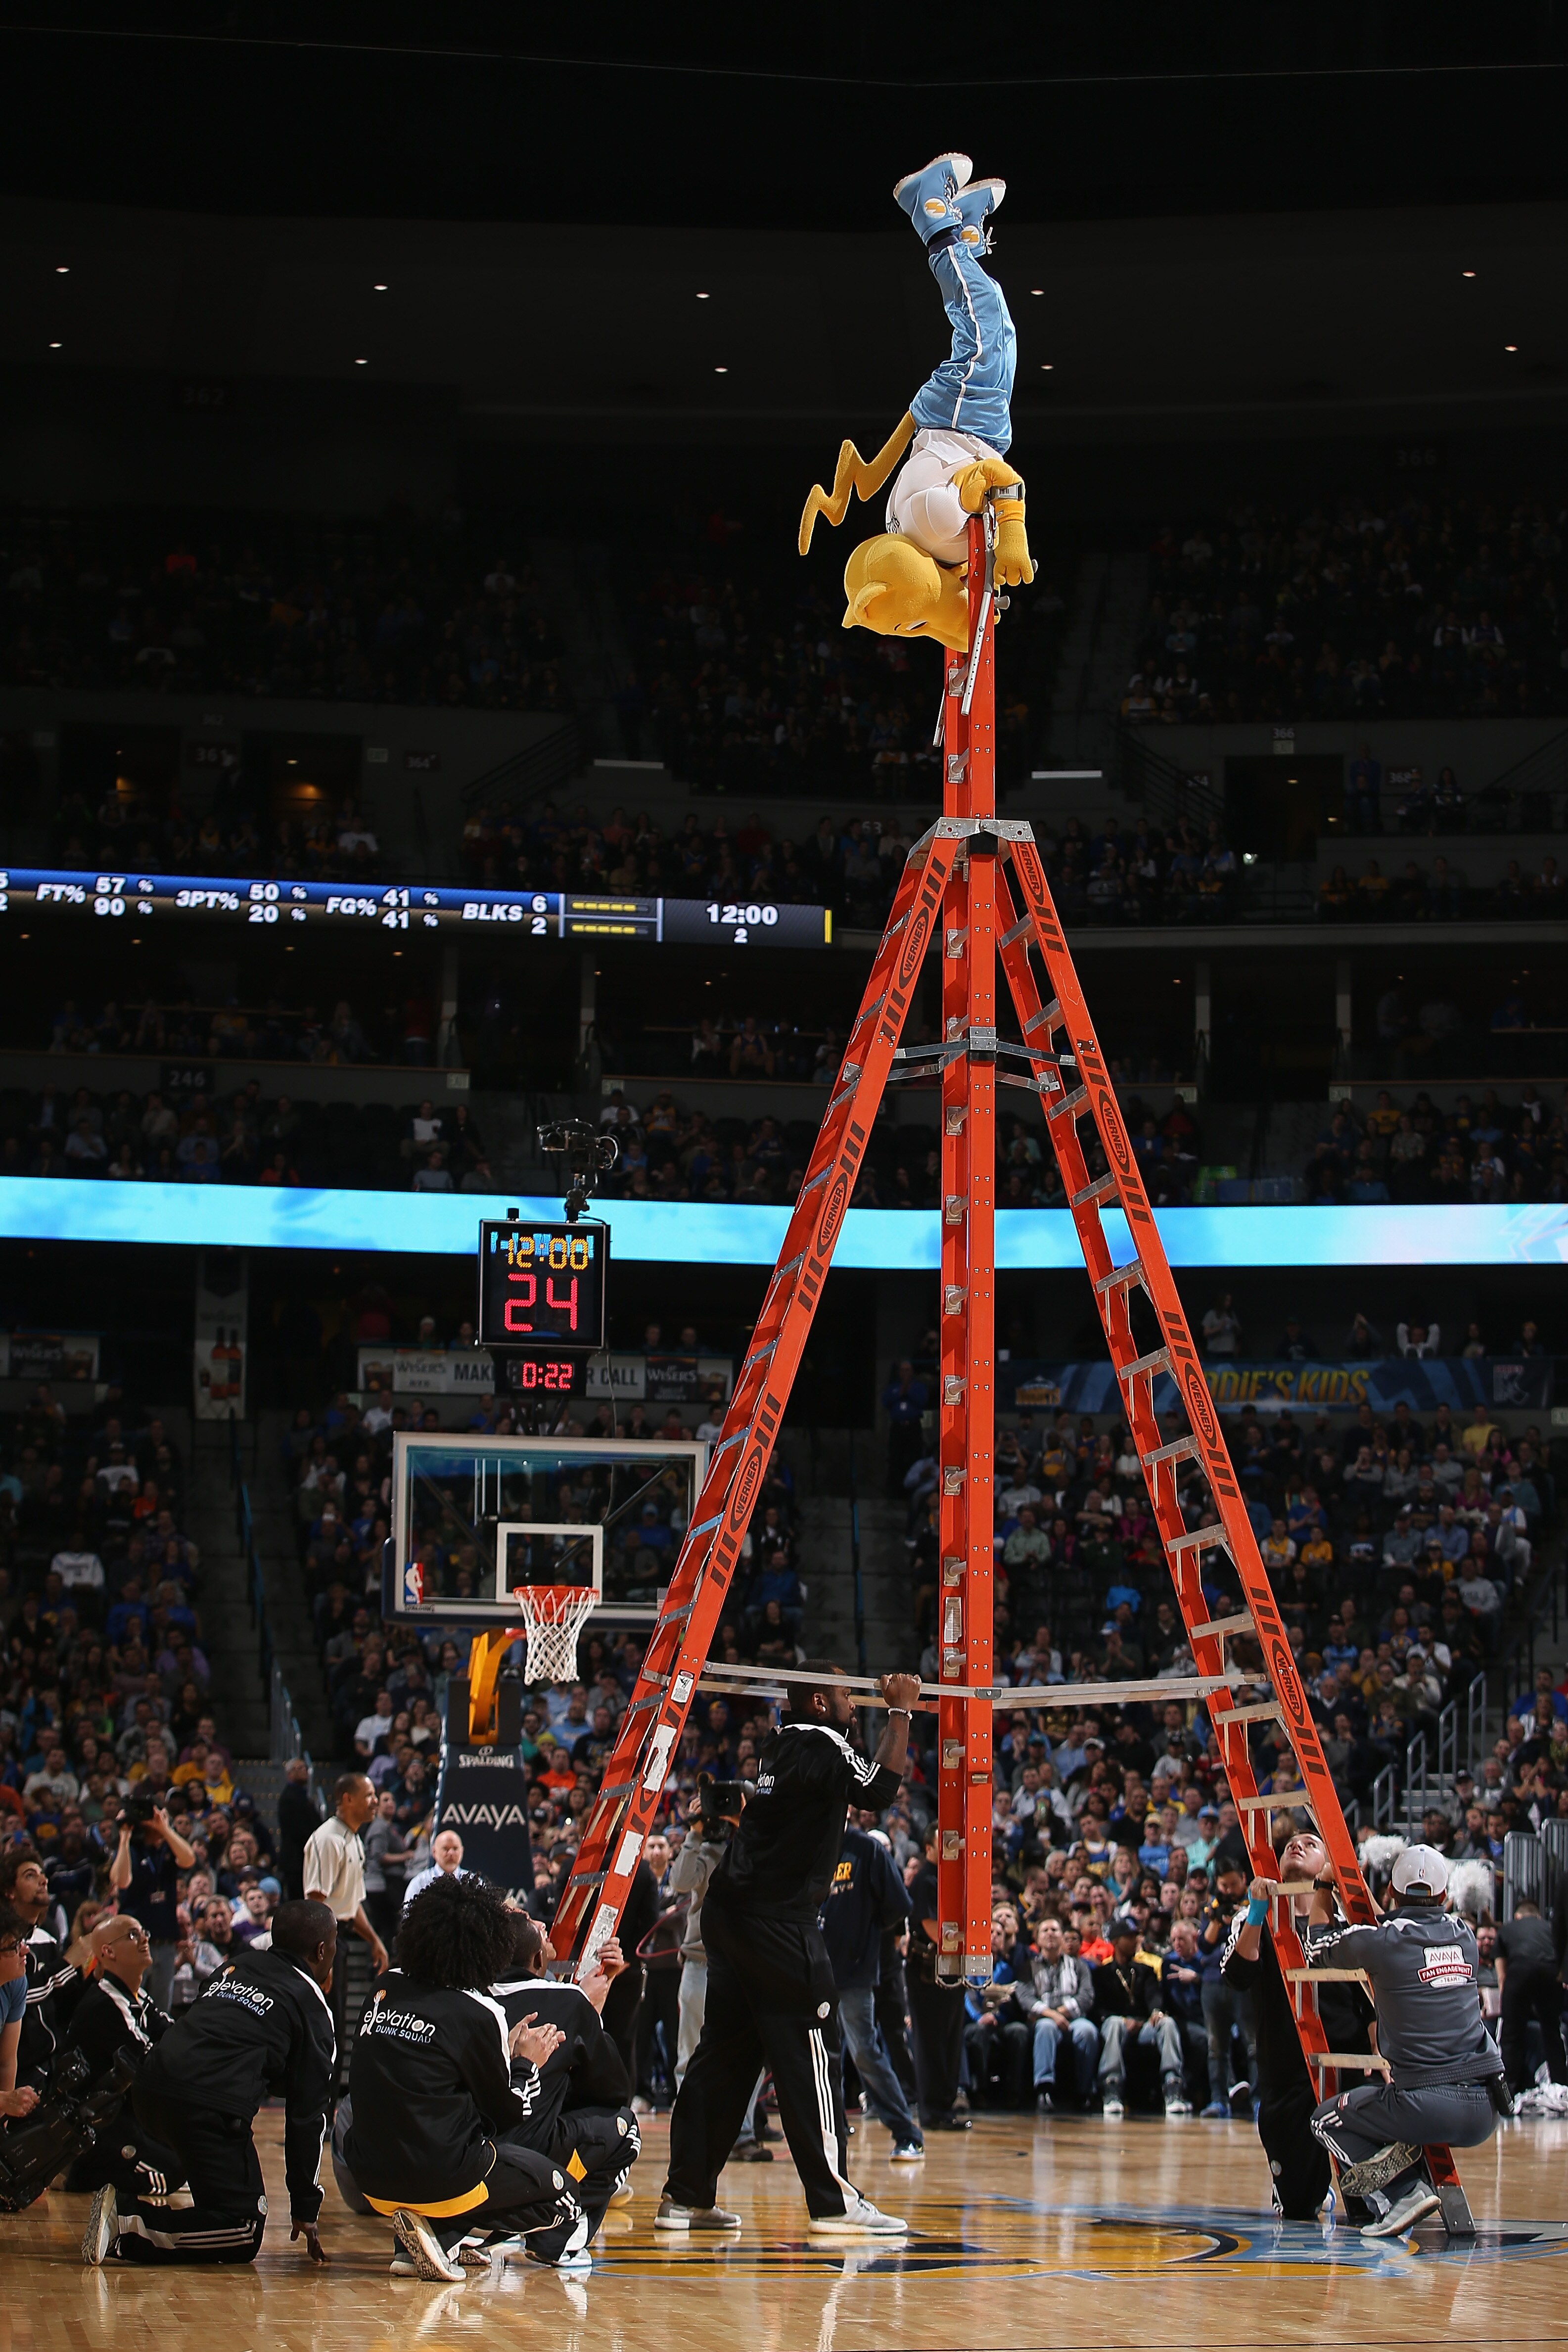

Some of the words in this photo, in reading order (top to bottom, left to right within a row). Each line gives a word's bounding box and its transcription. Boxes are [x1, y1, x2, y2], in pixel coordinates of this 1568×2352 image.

[1273, 727, 1295, 739] 366
[1019, 842, 1040, 890] WERNER
[36, 883, 86, 904] FT%
[95, 876, 126, 894] 57
[138, 879, 154, 892] %
[249, 883, 280, 901] 50
[291, 886, 307, 900] %
[93, 896, 126, 916] 90
[137, 901, 153, 914] %
[175, 890, 240, 911] 3PT%
[325, 897, 377, 917] FG%
[382, 888, 410, 907] 41
[423, 892, 439, 905] %
[532, 895, 547, 913] 6
[248, 904, 279, 923] 20
[291, 908, 307, 922] %
[382, 910, 409, 929] 41
[423, 914, 439, 927] %
[462, 903, 523, 922] BLKS
[706, 903, 779, 926] 12:00
[531, 916, 547, 935] 2
[734, 927, 748, 944] 2
[904, 921, 926, 972] WERNER
[169, 1069, 205, 1088] 246
[1104, 1107, 1126, 1160] WERNER
[822, 1187, 843, 1240] WERNER
[505, 1237, 589, 1270] 12:00
[505, 1273, 578, 1332] 24
[454, 1363, 494, 1381] MAK
[523, 1361, 573, 1389] 0:22
[600, 1368, 638, 1385] CALL
[1297, 1370, 1370, 1404] KIDS
[1190, 1381, 1212, 1434] WERNER
[736, 1461, 759, 1514] WERNER
[1278, 1658, 1300, 1711] WERNER
[459, 1754, 514, 1769] SPALDING
[441, 1803, 525, 1832] AVAYA
[1430, 1950, 1460, 1968] AVAYA
[1422, 1970, 1435, 1980] FAN
[1436, 1965, 1471, 1975] ENGAGEMENT
[202, 1973, 274, 2011] elevation
[217, 1991, 238, 2000] DUNK
[237, 1996, 265, 2016] SQUAD
[362, 2003, 436, 2037] elevation
[375, 2025, 398, 2036] DUNK
[398, 2029, 431, 2044] SQUAD
